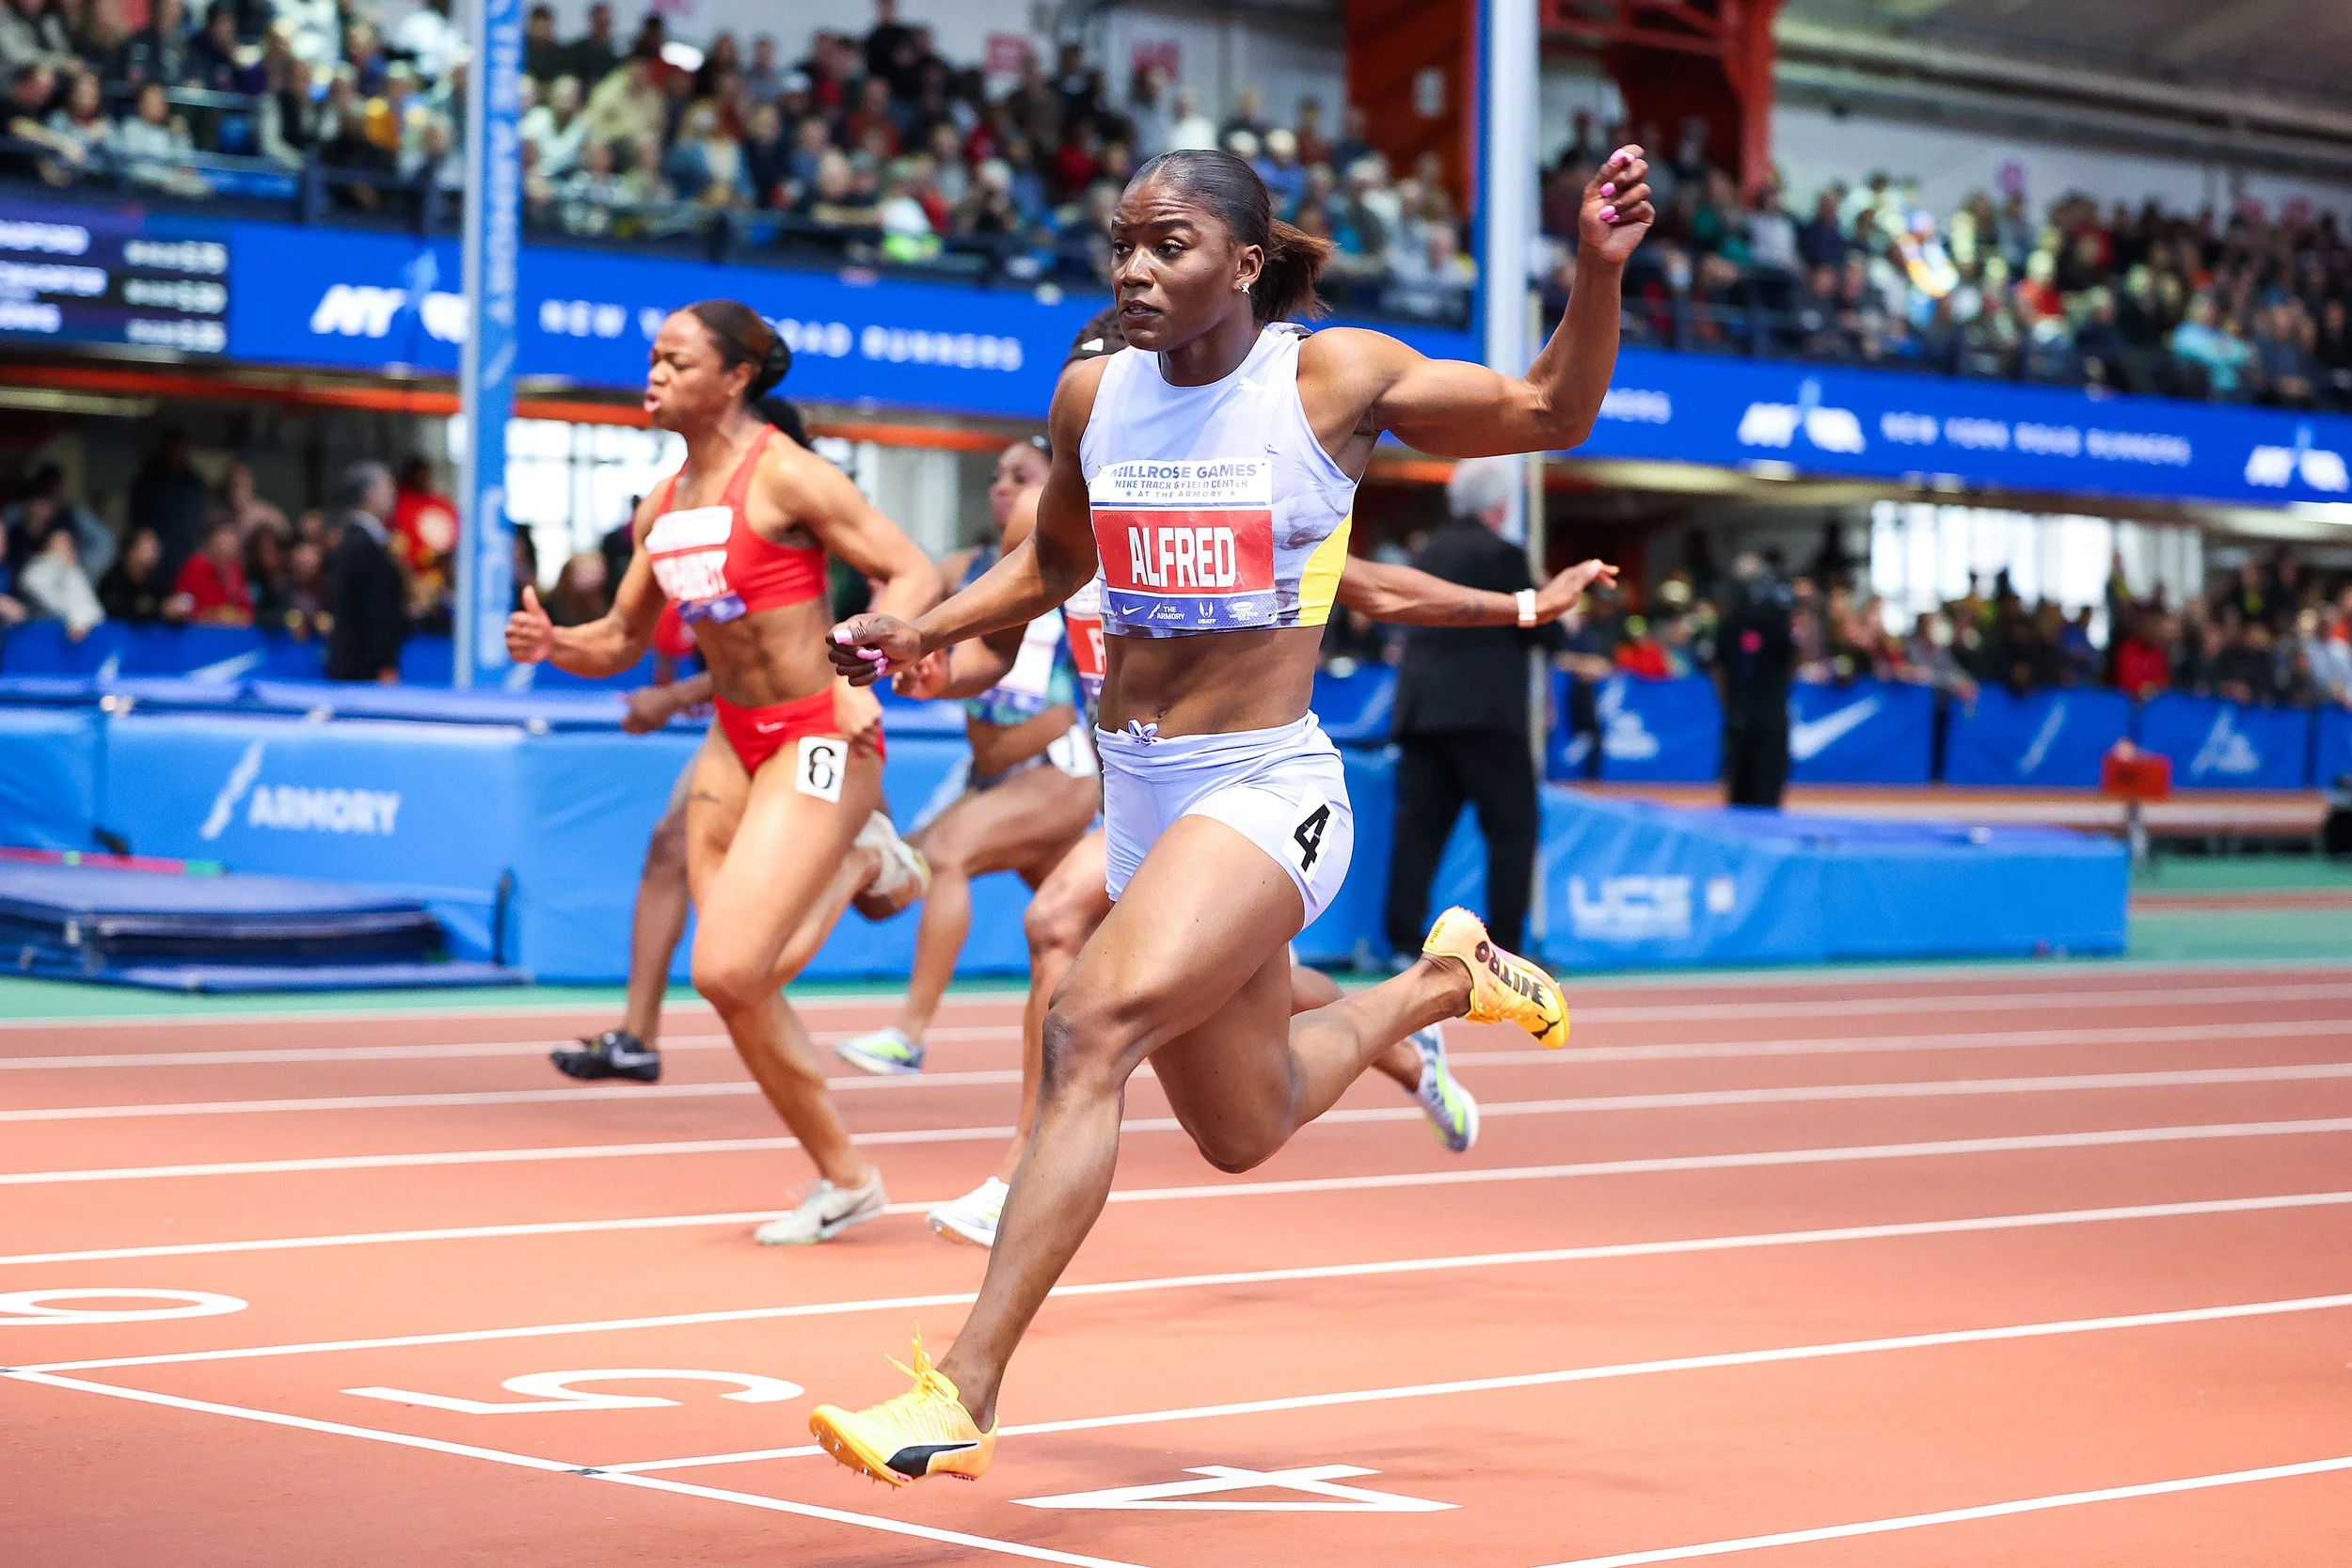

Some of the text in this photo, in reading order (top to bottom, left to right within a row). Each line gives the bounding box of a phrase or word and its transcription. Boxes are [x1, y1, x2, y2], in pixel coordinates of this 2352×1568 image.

[1115, 480, 1138, 489] NIKE
[1140, 480, 1172, 489] TRACK
[1182, 480, 1210, 489] FIELD
[1211, 479, 1248, 489] CENTER
[1197, 464, 1257, 479] GAMES
[1128, 526, 1235, 588] ALFRED
[808, 746, 835, 790] 6
[247, 783, 402, 836] ARMORY
[1294, 803, 1330, 873] 4
[1474, 940, 1546, 1009] NITRO
[339, 1368, 805, 1415] 5
[1007, 1464, 1465, 1513] 4
